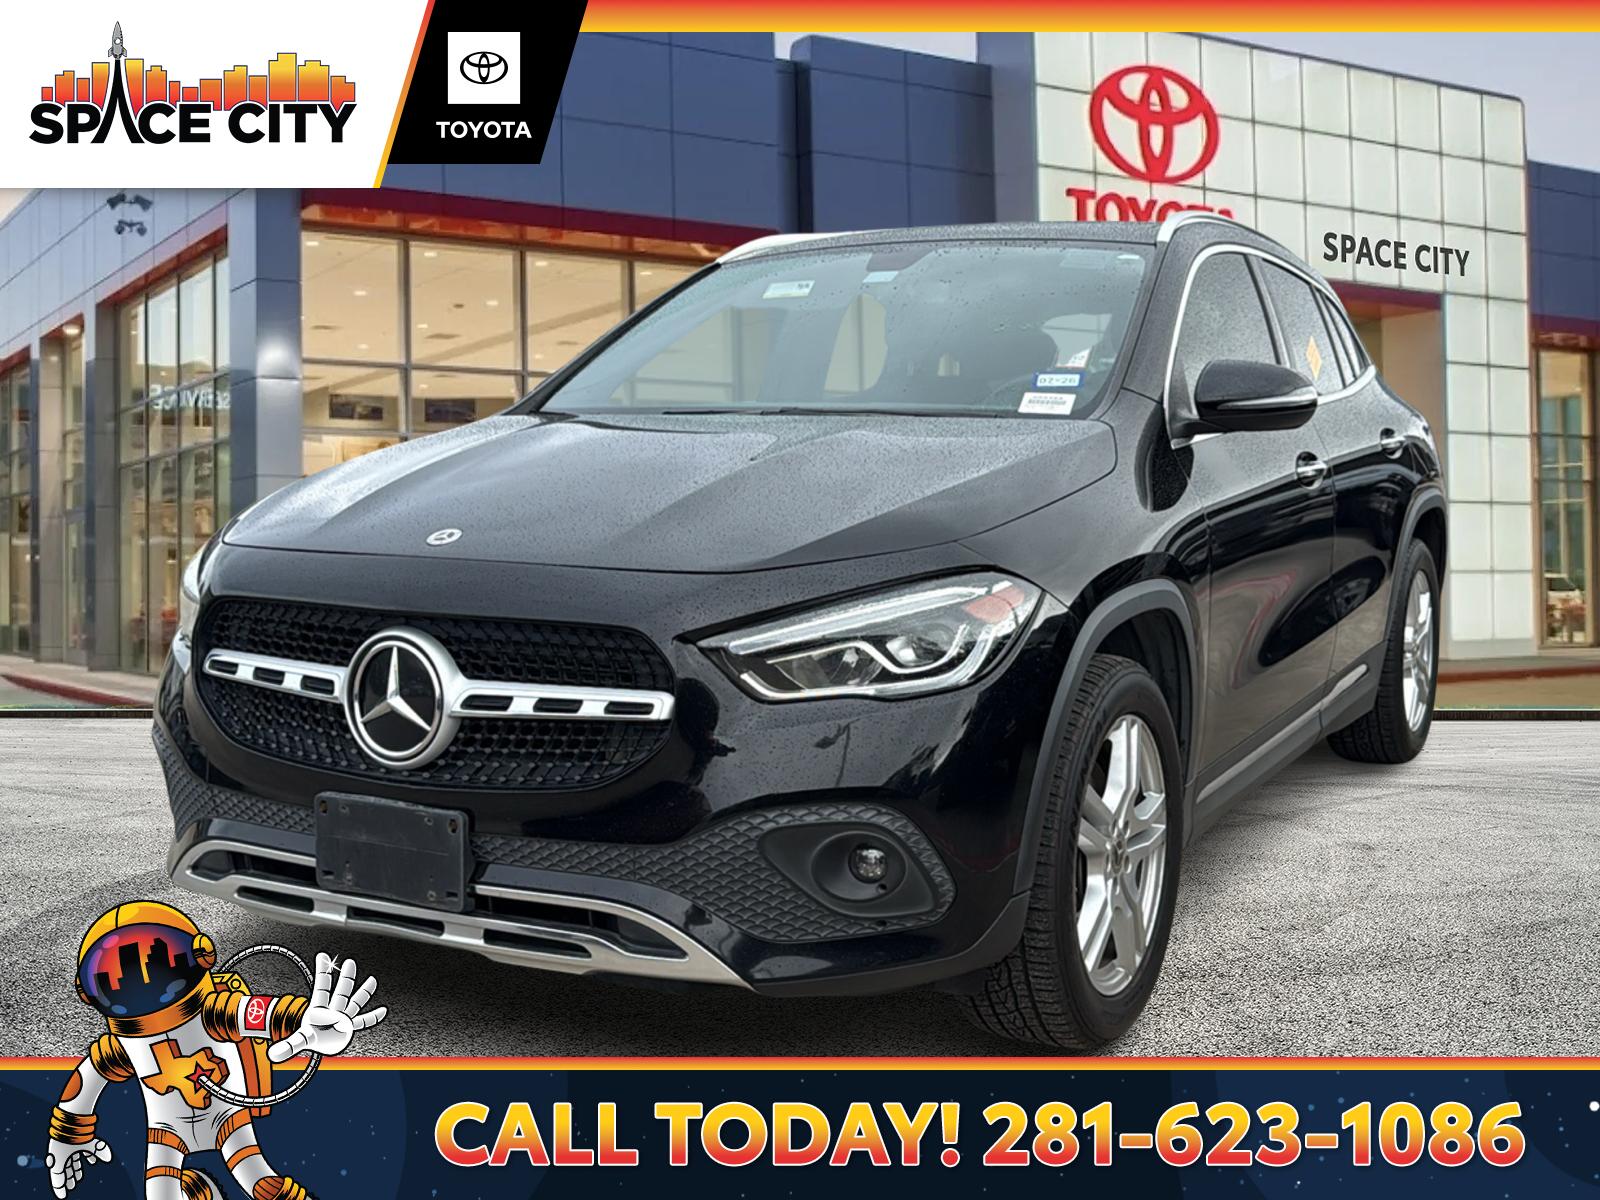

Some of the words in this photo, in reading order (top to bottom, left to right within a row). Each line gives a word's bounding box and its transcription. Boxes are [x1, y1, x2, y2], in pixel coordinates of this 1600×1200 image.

[1066, 188, 1233, 222] TOY
[1323, 232, 1407, 270] SPACE
[1415, 245, 1470, 276] CITY
